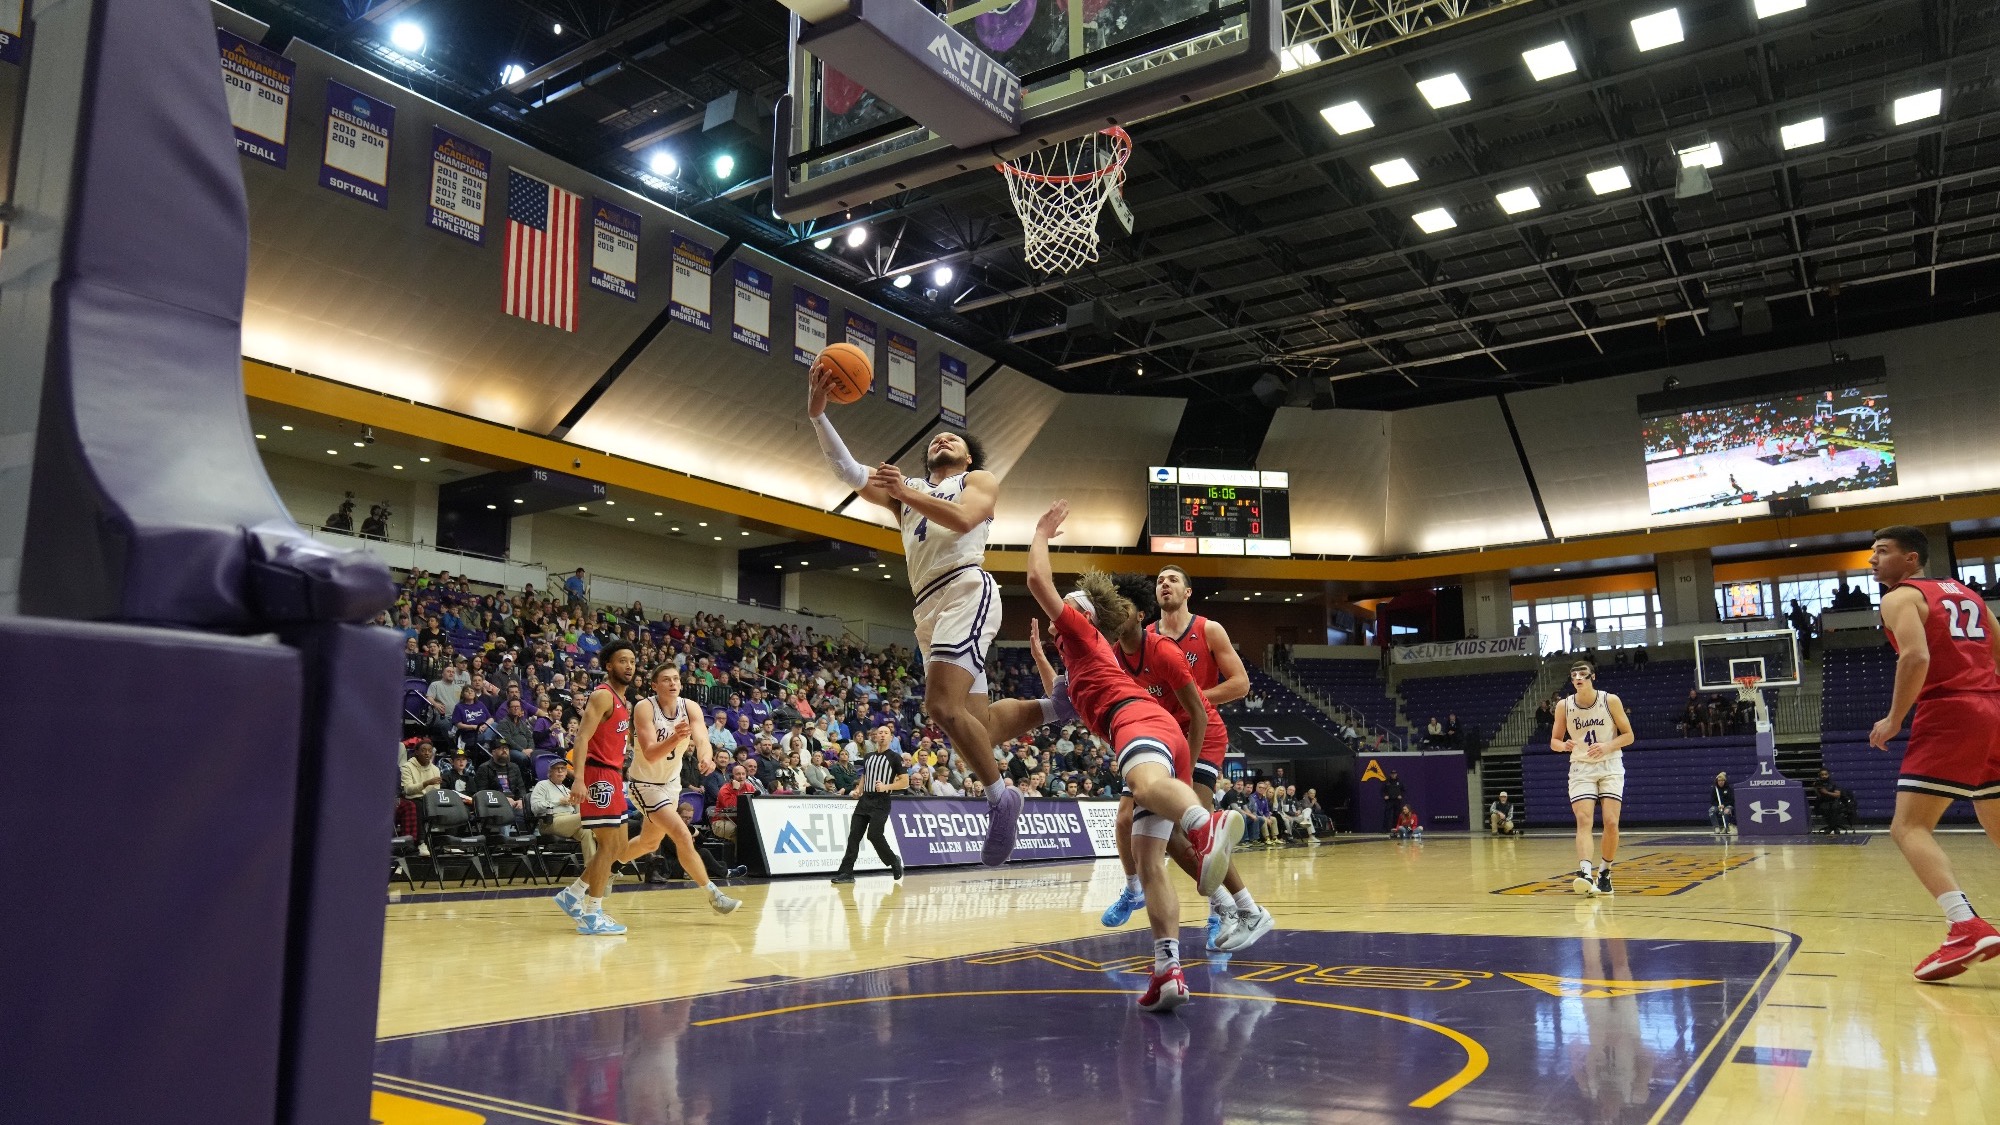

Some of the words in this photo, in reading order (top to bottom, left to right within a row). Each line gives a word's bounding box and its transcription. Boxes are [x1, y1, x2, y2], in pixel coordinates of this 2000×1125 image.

[221, 47, 291, 84] TOURNAMENT
[220, 57, 290, 94] CHAMPIONS
[942, 67, 960, 85] SPORTS
[953, 41, 1019, 113] ELITE
[225, 74, 252, 92] 2010
[258, 88, 284, 105] 2019
[331, 107, 388, 137] REGIONALS
[332, 132, 356, 148] 2019
[333, 121, 356, 137] 2010
[361, 132, 384, 148] 2014
[234, 138, 276, 161] FTBALL
[438, 144, 485, 171] ACADEMIC
[434, 151, 488, 180] CHAMPIONS
[437, 166, 458, 180] 2010
[462, 176, 482, 190] 2014
[329, 177, 379, 202] SOFTBALL
[436, 176, 457, 190] 2015
[461, 186, 482, 200] 2016
[434, 196, 456, 211] 2022
[435, 186, 457, 200] 2017
[461, 196, 481, 210] 2019
[431, 217, 480, 241] ATHLETICS
[432, 208, 480, 233] LIPSCOMB
[594, 218, 639, 242] CHAMPIONS
[597, 240, 614, 253] 2019
[617, 239, 634, 251] 2010
[672, 254, 712, 275] CHAMPIONS
[673, 246, 712, 267] TOURNAMENT
[591, 276, 636, 299] BASKETBALL
[603, 272, 626, 288] MEN'S
[735, 279, 771, 300] TOURNAMENT
[670, 308, 711, 330] BASKETBALL
[680, 305, 701, 319] MEN'S
[733, 331, 769, 352] BASKETBALL
[742, 328, 761, 342] MEN'S
[533, 470, 548, 481] 115
[592, 484, 605, 495] 114
[1208, 487, 1236, 500] 16:06
[1192, 504, 1199, 516] 2
[1220, 505, 1225, 517] 1
[1251, 507, 1259, 517] 4
[913, 515, 928, 542] 4
[1185, 520, 1193, 532] 0
[1252, 522, 1259, 534] 0
[1678, 575, 1692, 583] 110
[1941, 599, 1985, 638] 22
[1417, 643, 1453, 659] ELITE
[1454, 640, 1486, 656] KIDS
[1489, 637, 1527, 654] ZONE
[1572, 717, 1605, 731] Bisons
[1239, 726, 1309, 746] L
[1583, 729, 1598, 747] 41
[1760, 761, 1773, 775] L
[1749, 779, 1786, 787] LIPSCOMB
[437, 790, 450, 804] L
[486, 791, 499, 804] L
[898, 813, 990, 838] LIPSCOM
[1017, 813, 1082, 835] BISONS
[1095, 829, 1114, 839] INFO
[929, 841, 963, 854] ALLEN
[1013, 838, 1059, 850] ASHVILLE,
[1058, 838, 1072, 848] TN
[1095, 839, 1111, 849] THE
[798, 859, 820, 868] SPORTS
